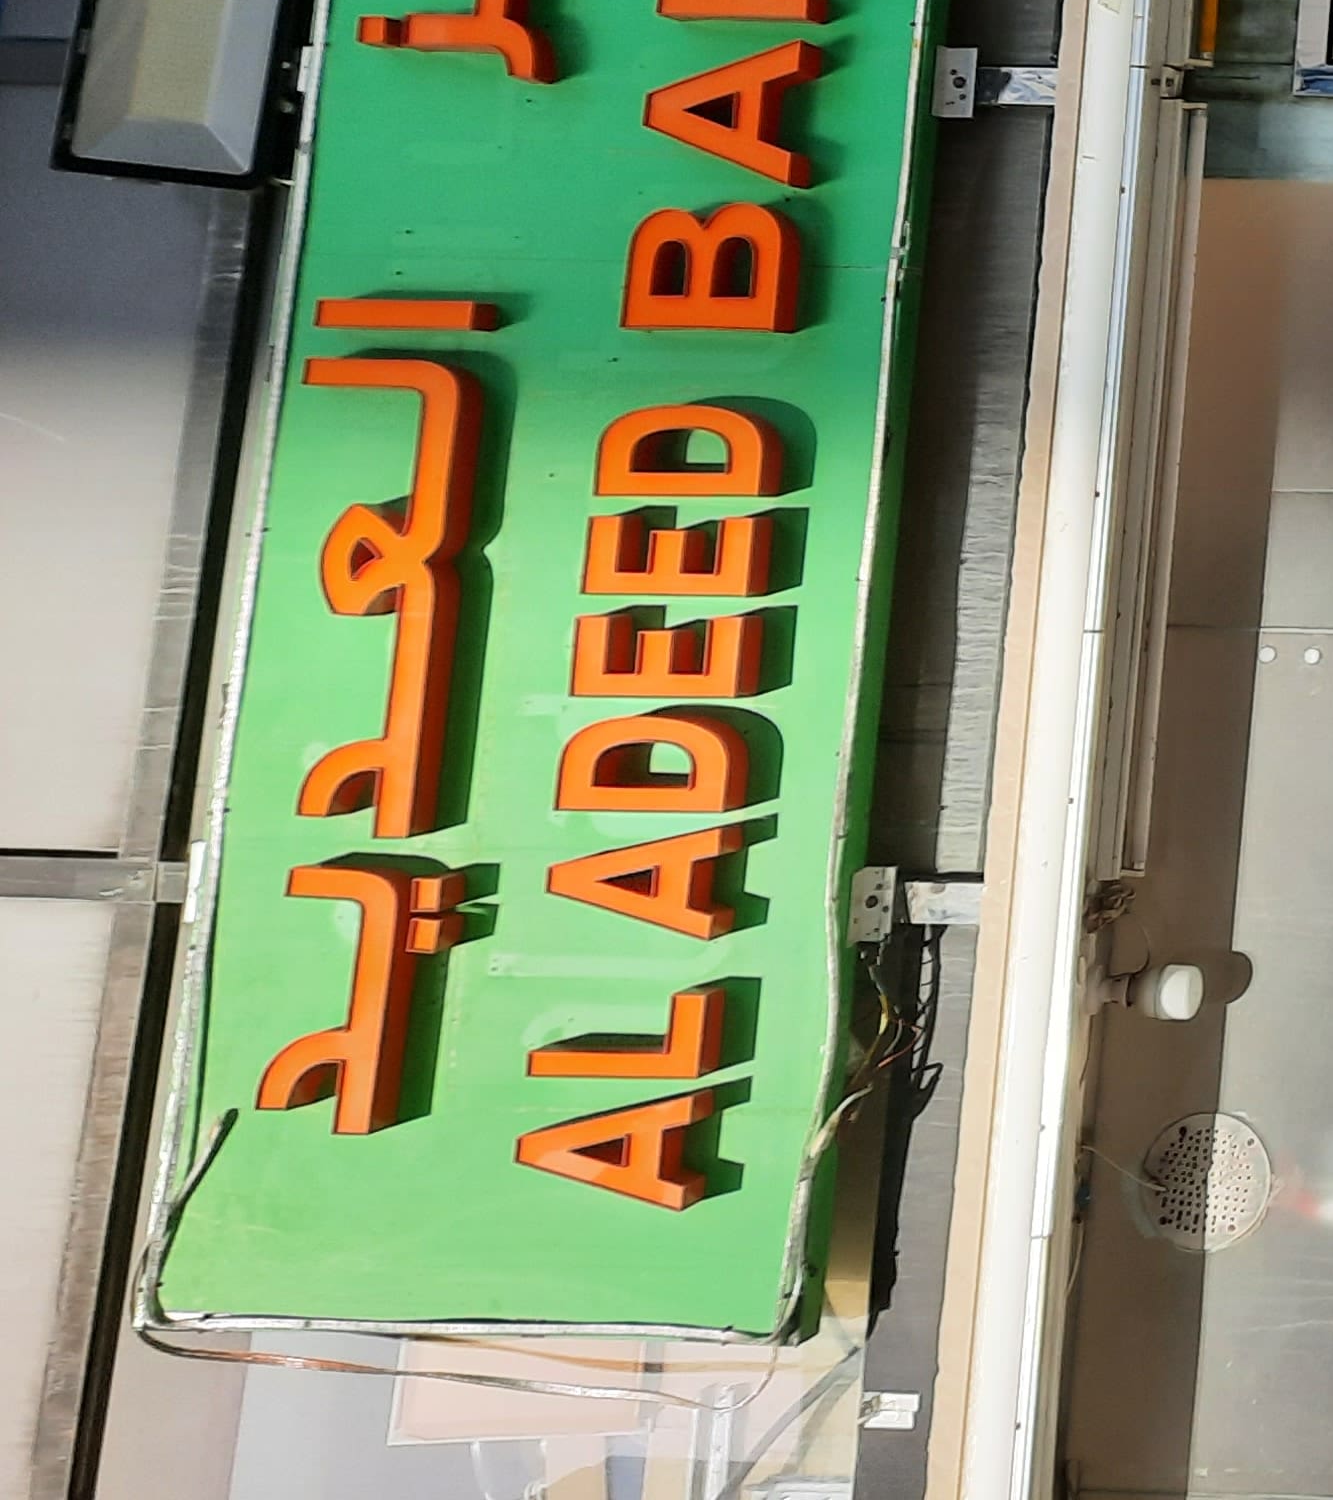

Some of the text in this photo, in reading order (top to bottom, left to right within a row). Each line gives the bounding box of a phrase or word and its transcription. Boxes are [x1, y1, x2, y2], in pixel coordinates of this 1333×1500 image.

[254, 300, 500, 1135] العديد
[546, 403, 784, 940] ADEED
[514, 988, 726, 1211] AL
